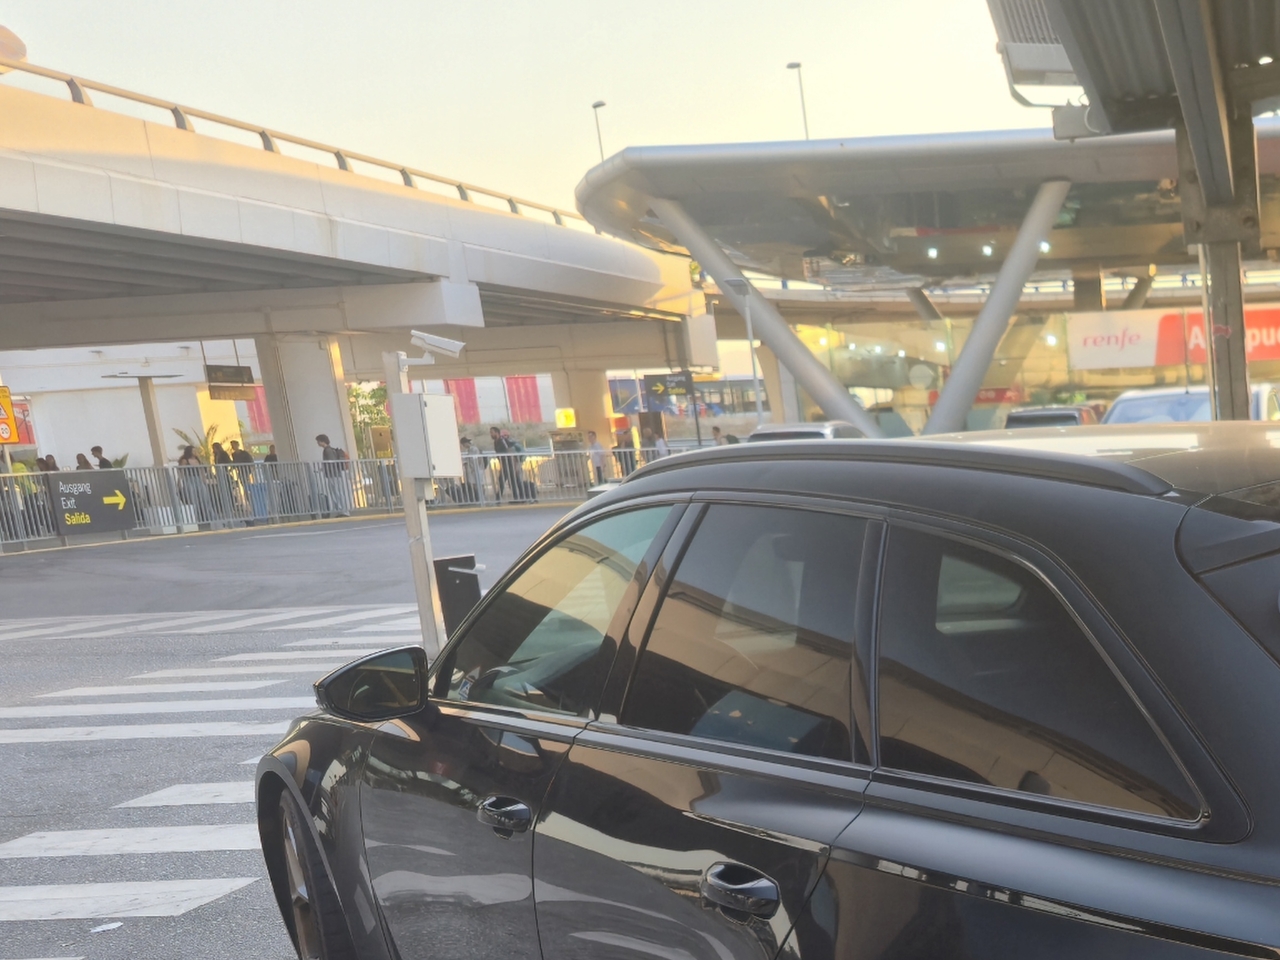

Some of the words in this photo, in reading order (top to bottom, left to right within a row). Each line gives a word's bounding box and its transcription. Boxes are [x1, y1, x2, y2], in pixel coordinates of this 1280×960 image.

[1083, 327, 1141, 352] renfe
[59, 481, 92, 495] Ausgang
[61, 497, 77, 509] Exit
[65, 512, 91, 525] Salida
